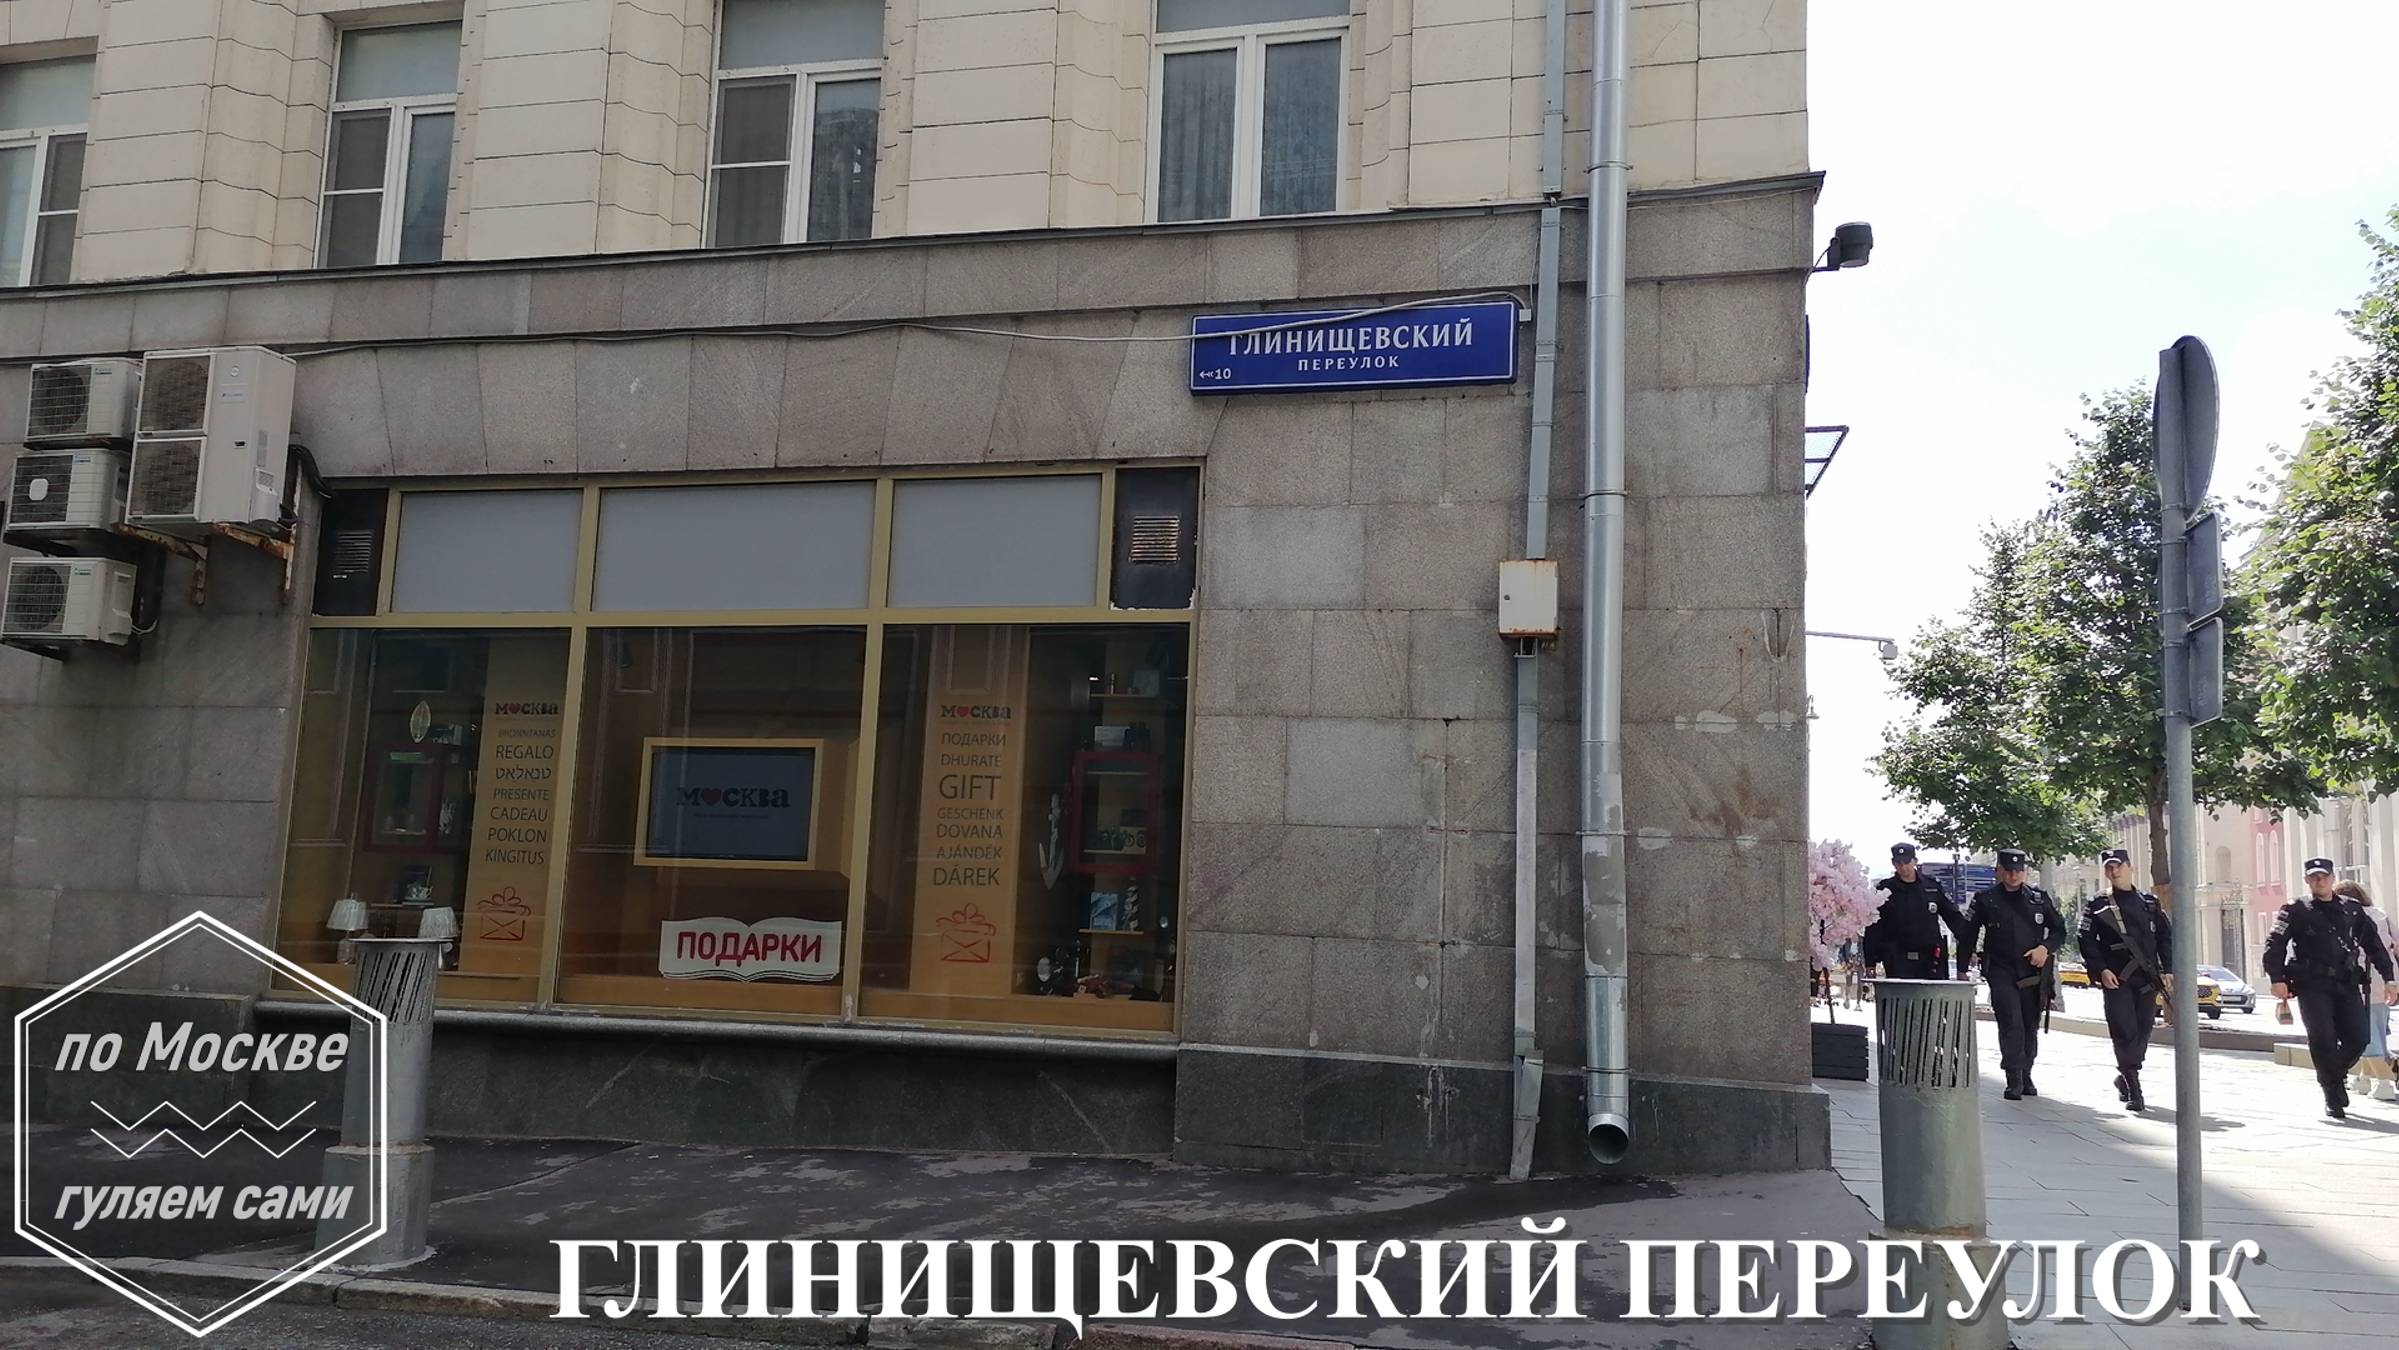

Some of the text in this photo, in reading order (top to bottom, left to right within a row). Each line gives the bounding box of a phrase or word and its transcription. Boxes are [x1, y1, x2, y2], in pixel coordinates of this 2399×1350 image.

[1229, 317, 1473, 356] ГЛИНИЩЕВСКИЙ
[1298, 355, 1399, 371] ПЕРЕУЛОК
[1215, 367, 1232, 380] 10
[941, 733, 1006, 747] ПОДАРКИ
[495, 744, 554, 760] REGALO
[493, 787, 550, 801] PRESENTE
[939, 774, 1002, 800] GIFT
[490, 806, 548, 822] CADEAU
[937, 807, 1004, 820] GESCHENK
[487, 827, 547, 843] POKLON
[936, 823, 1003, 839] DOVANA
[485, 848, 545, 865] KINGITUS
[933, 865, 1001, 886] DÁREK
[677, 931, 822, 967] ПОДАРКИ
